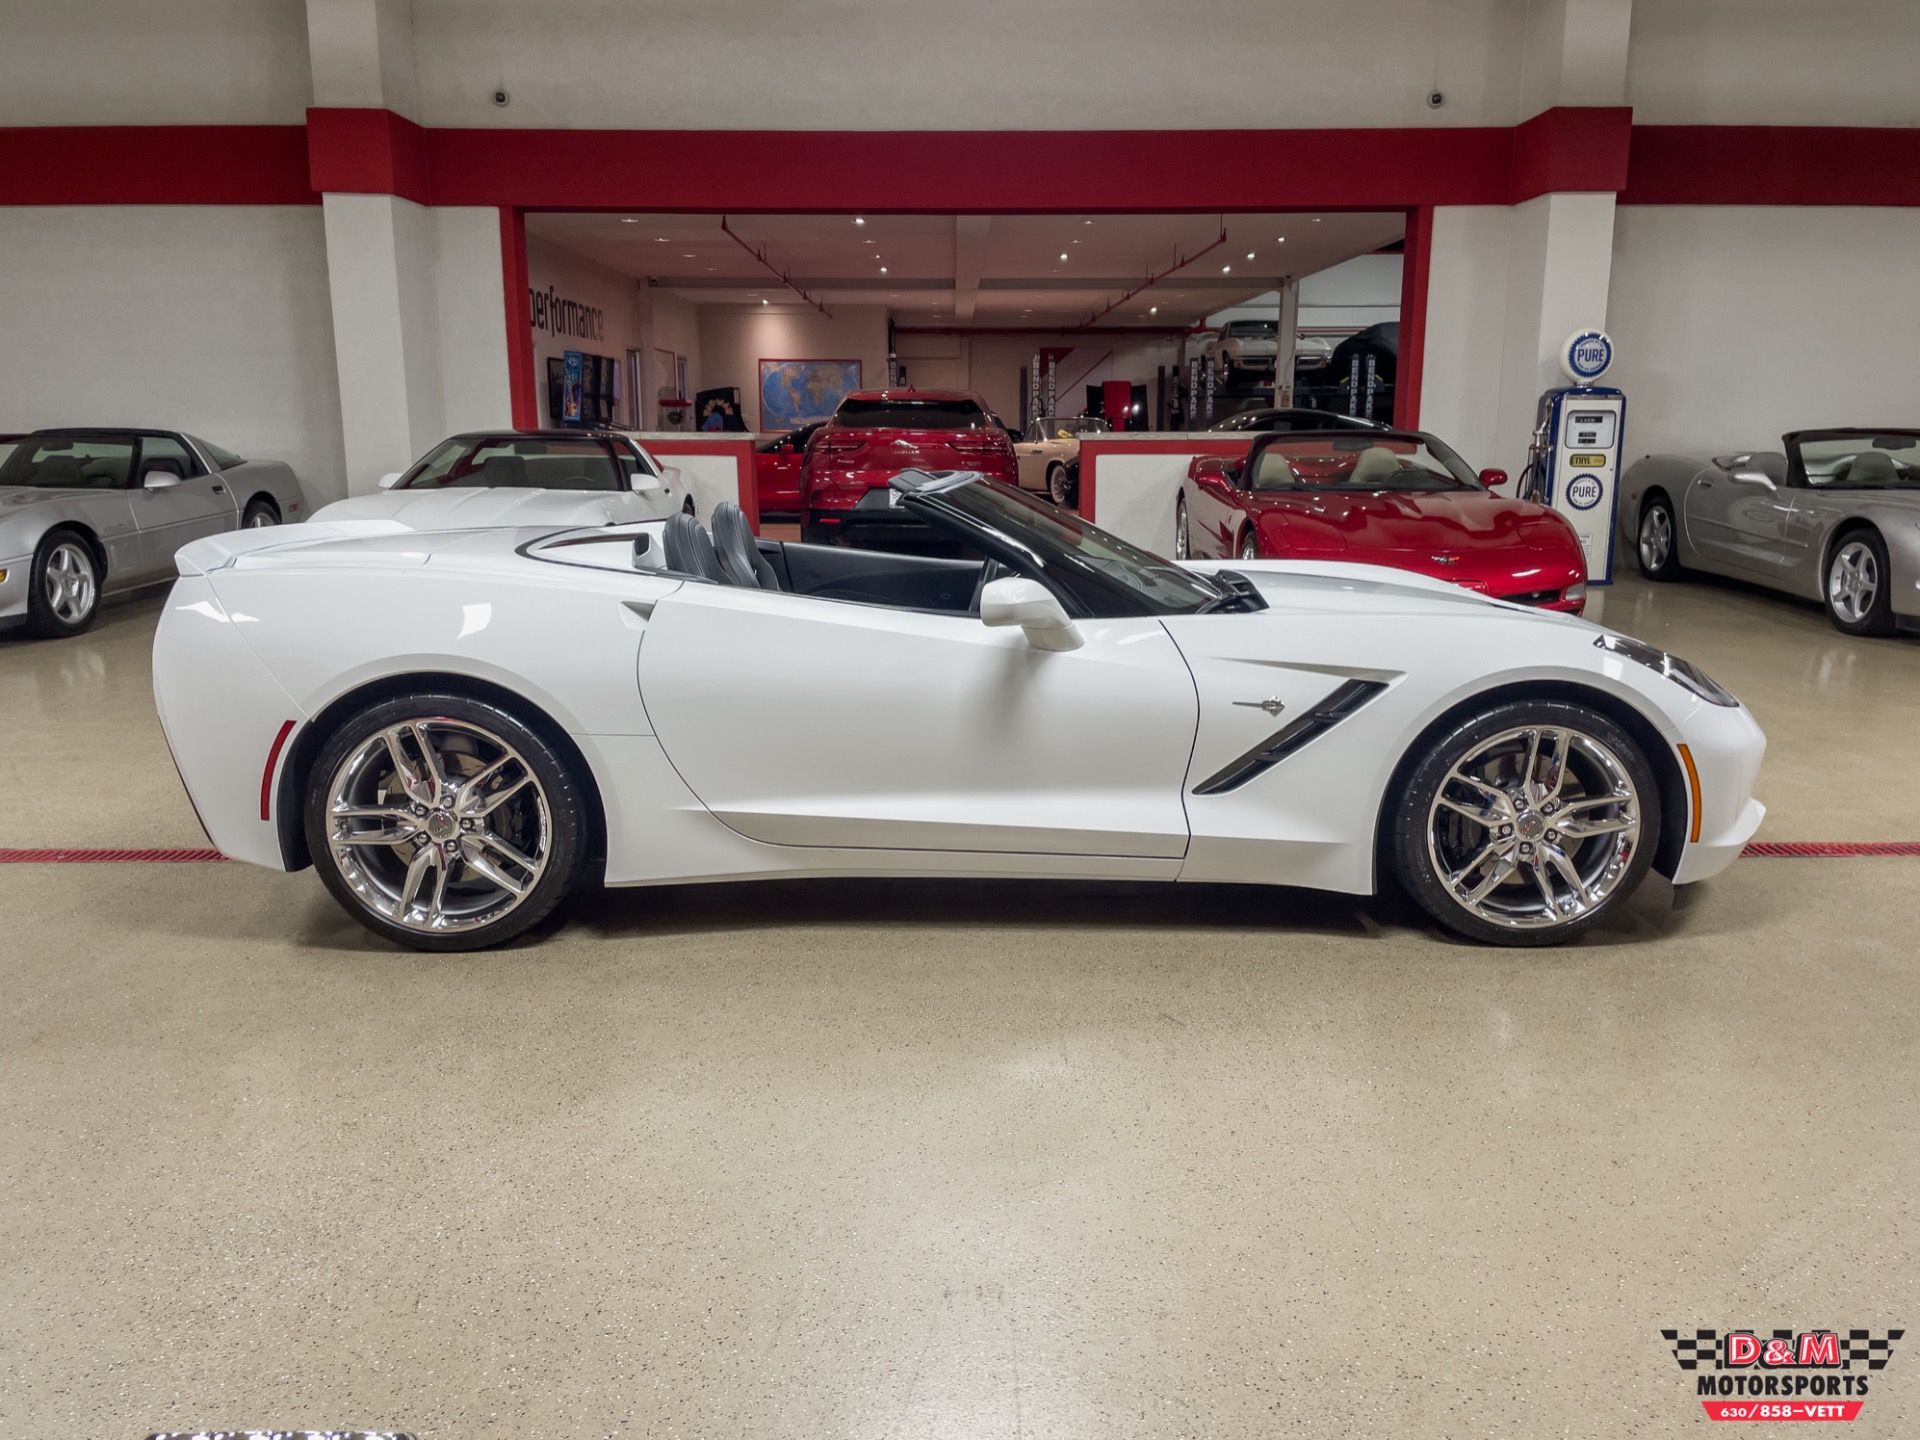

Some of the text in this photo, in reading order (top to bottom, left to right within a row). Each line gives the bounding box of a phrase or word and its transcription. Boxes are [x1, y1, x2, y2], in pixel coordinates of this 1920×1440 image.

[1577, 348, 1605, 362] PURE
[1190, 361, 1198, 410] BENDPAK
[1206, 361, 1215, 410] BENDPAK
[1349, 359, 1359, 410] BENDPAK
[1366, 359, 1376, 410] BENDPAK
[1572, 456, 1591, 465] ETHYL
[1572, 485, 1597, 498] PURE
